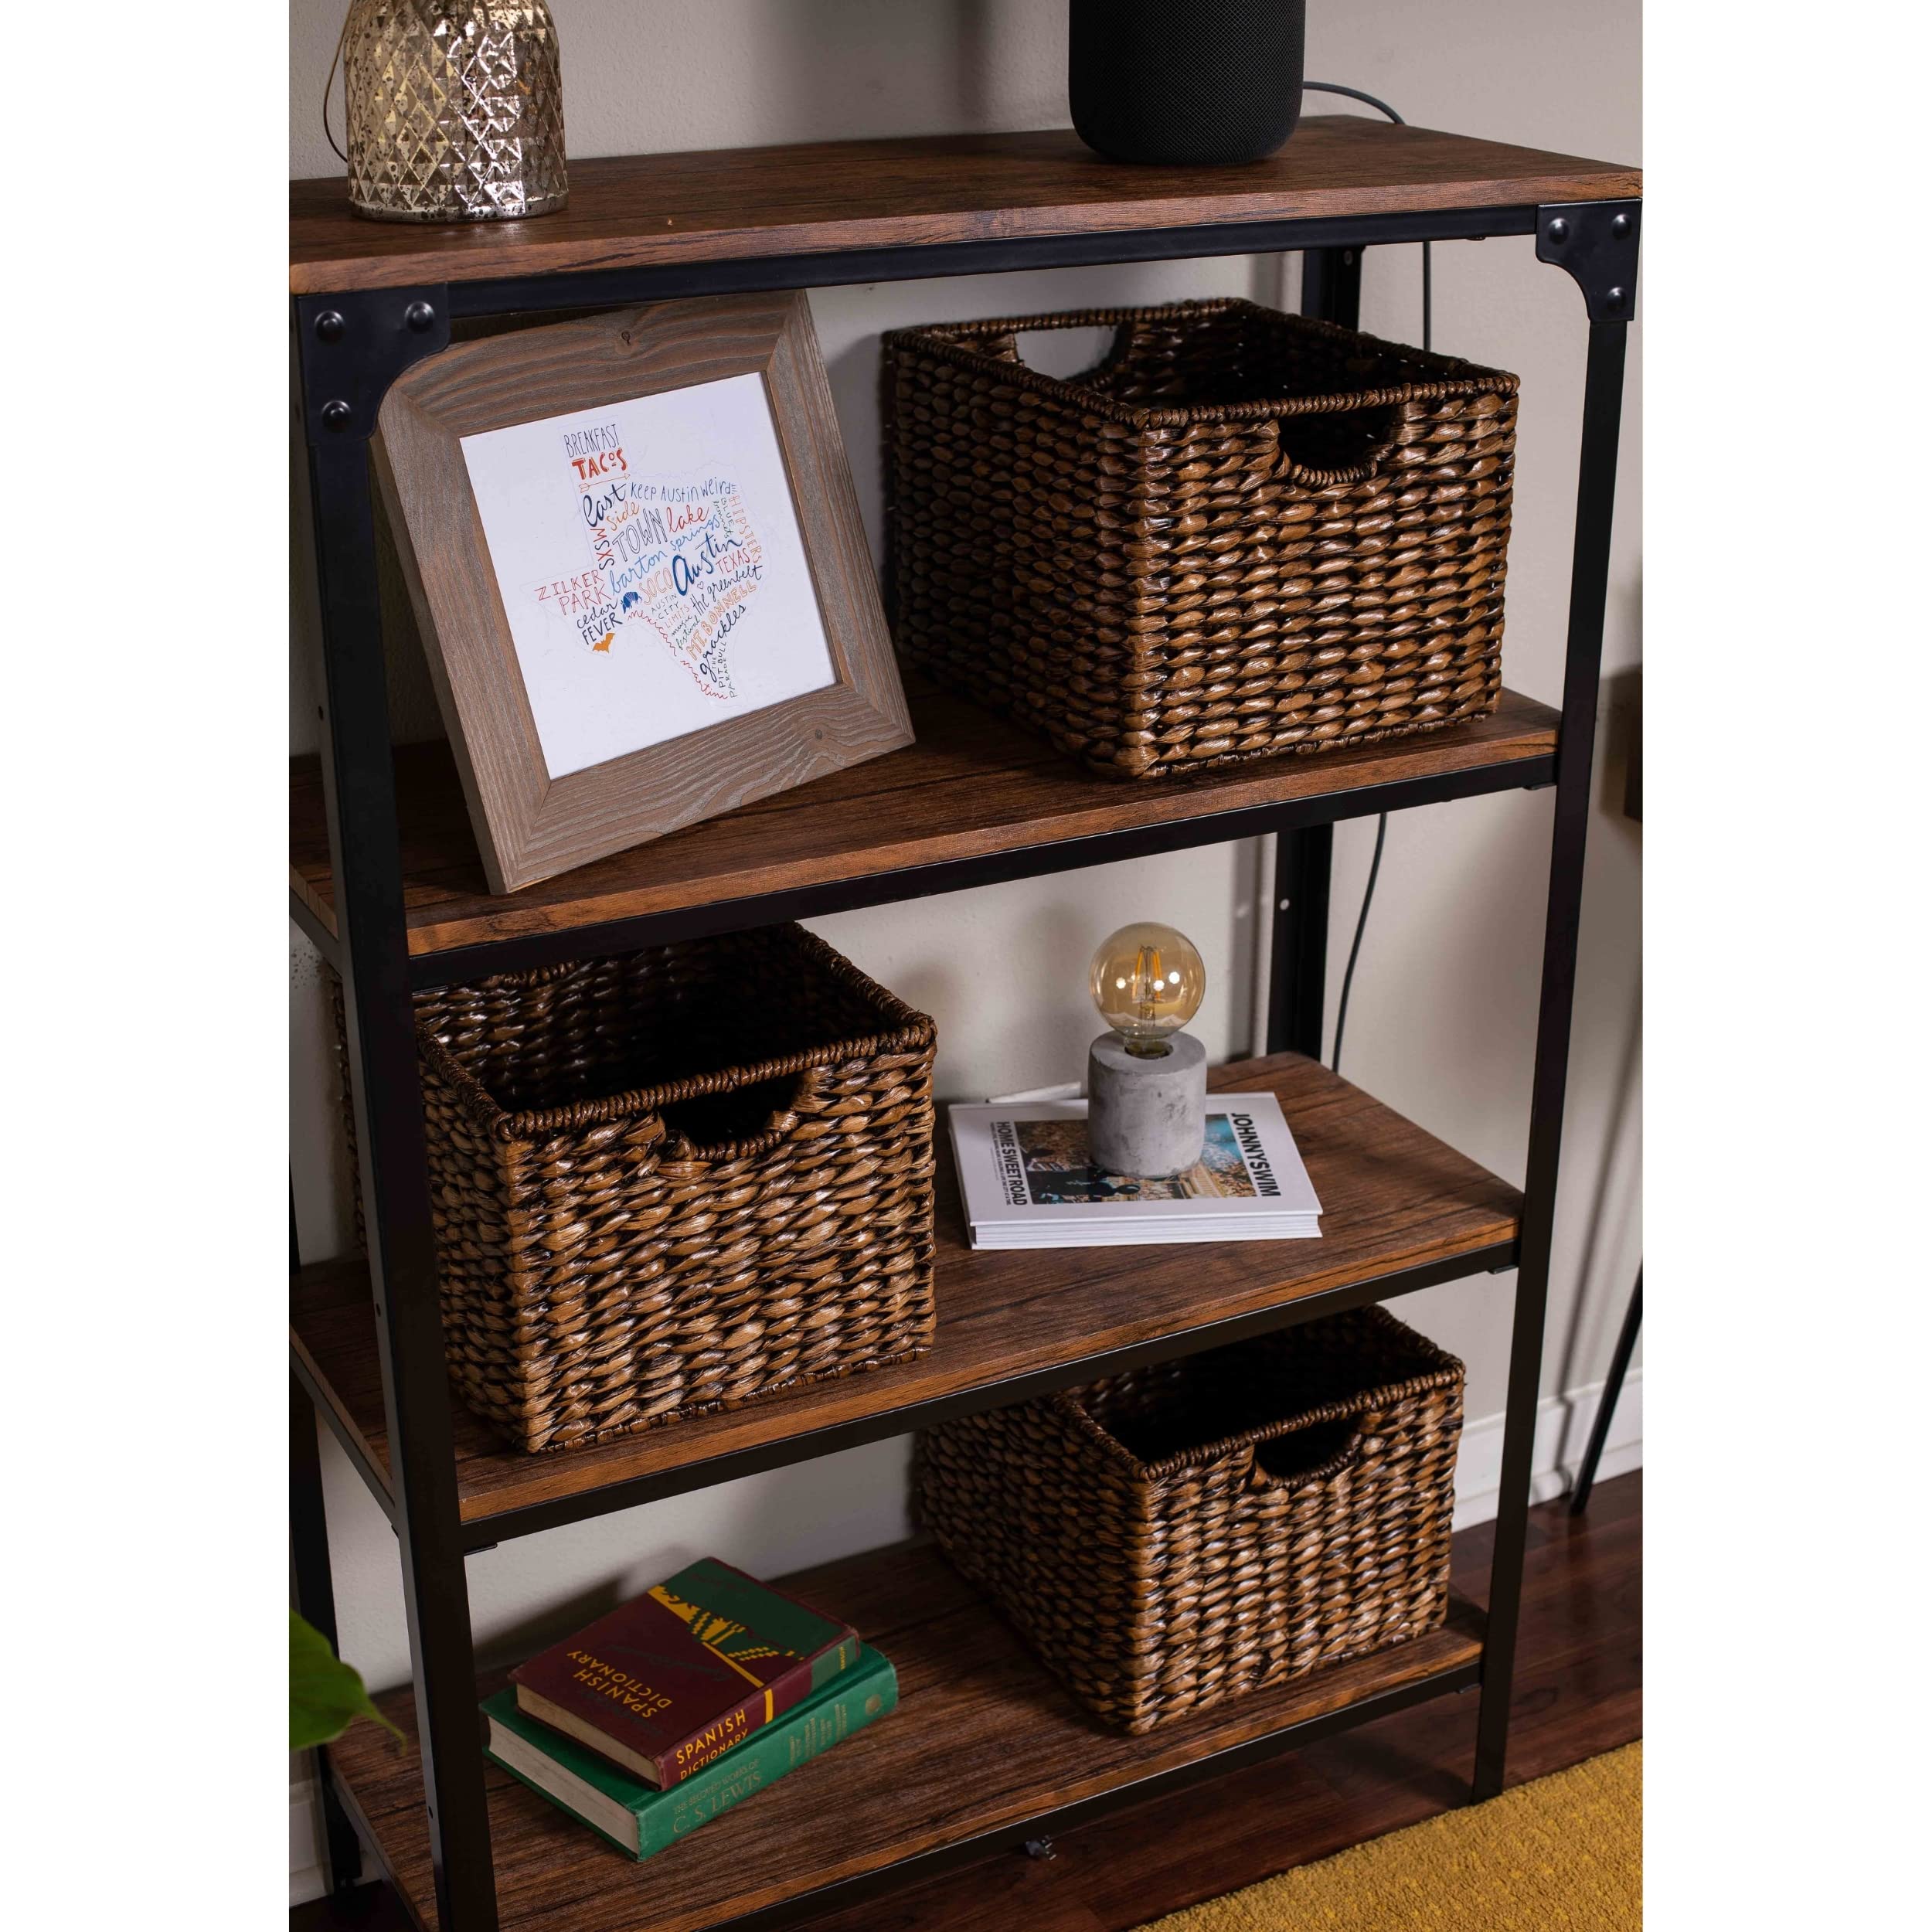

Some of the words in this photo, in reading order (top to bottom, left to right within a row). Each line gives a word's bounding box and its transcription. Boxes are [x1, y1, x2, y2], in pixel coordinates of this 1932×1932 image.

[564, 423, 619, 457] BREAKFAST
[572, 447, 628, 480] TACOS
[666, 505, 709, 532] lake
[720, 497, 735, 526] BLUE
[612, 508, 668, 562] TOWN
[729, 495, 762, 564] HIPSTERS
[590, 529, 614, 570] SXSW
[609, 549, 668, 596] barton
[670, 514, 720, 552] springs
[716, 547, 750, 575] TEXAS
[534, 570, 604, 600] ZILKER
[559, 583, 612, 615] PARK
[638, 567, 673, 606] SOCO
[690, 594, 709, 617] the
[707, 564, 763, 602] greenbelt
[577, 597, 618, 629] cedar
[651, 593, 677, 614] AUSTIN
[658, 600, 679, 619] CITY
[664, 604, 690, 628] LIMITS
[701, 580, 757, 636] BONNELL
[582, 612, 623, 645] FEVER
[699, 605, 747, 683] grackles
[995, 1121, 1015, 1148] HOME
[1002, 1148, 1022, 1179] SWEET
[1231, 1112, 1281, 1197] JOHNNYSWIM
[1009, 1179, 1028, 1206] ROAD
[566, 1650, 672, 1708] DICTIONARY
[573, 1669, 658, 1718] SPANISH
[676, 1709, 746, 1764] SPANISH
[680, 1728, 748, 1781] DICTIONARY
[711, 1770, 762, 1814] LEWIS
